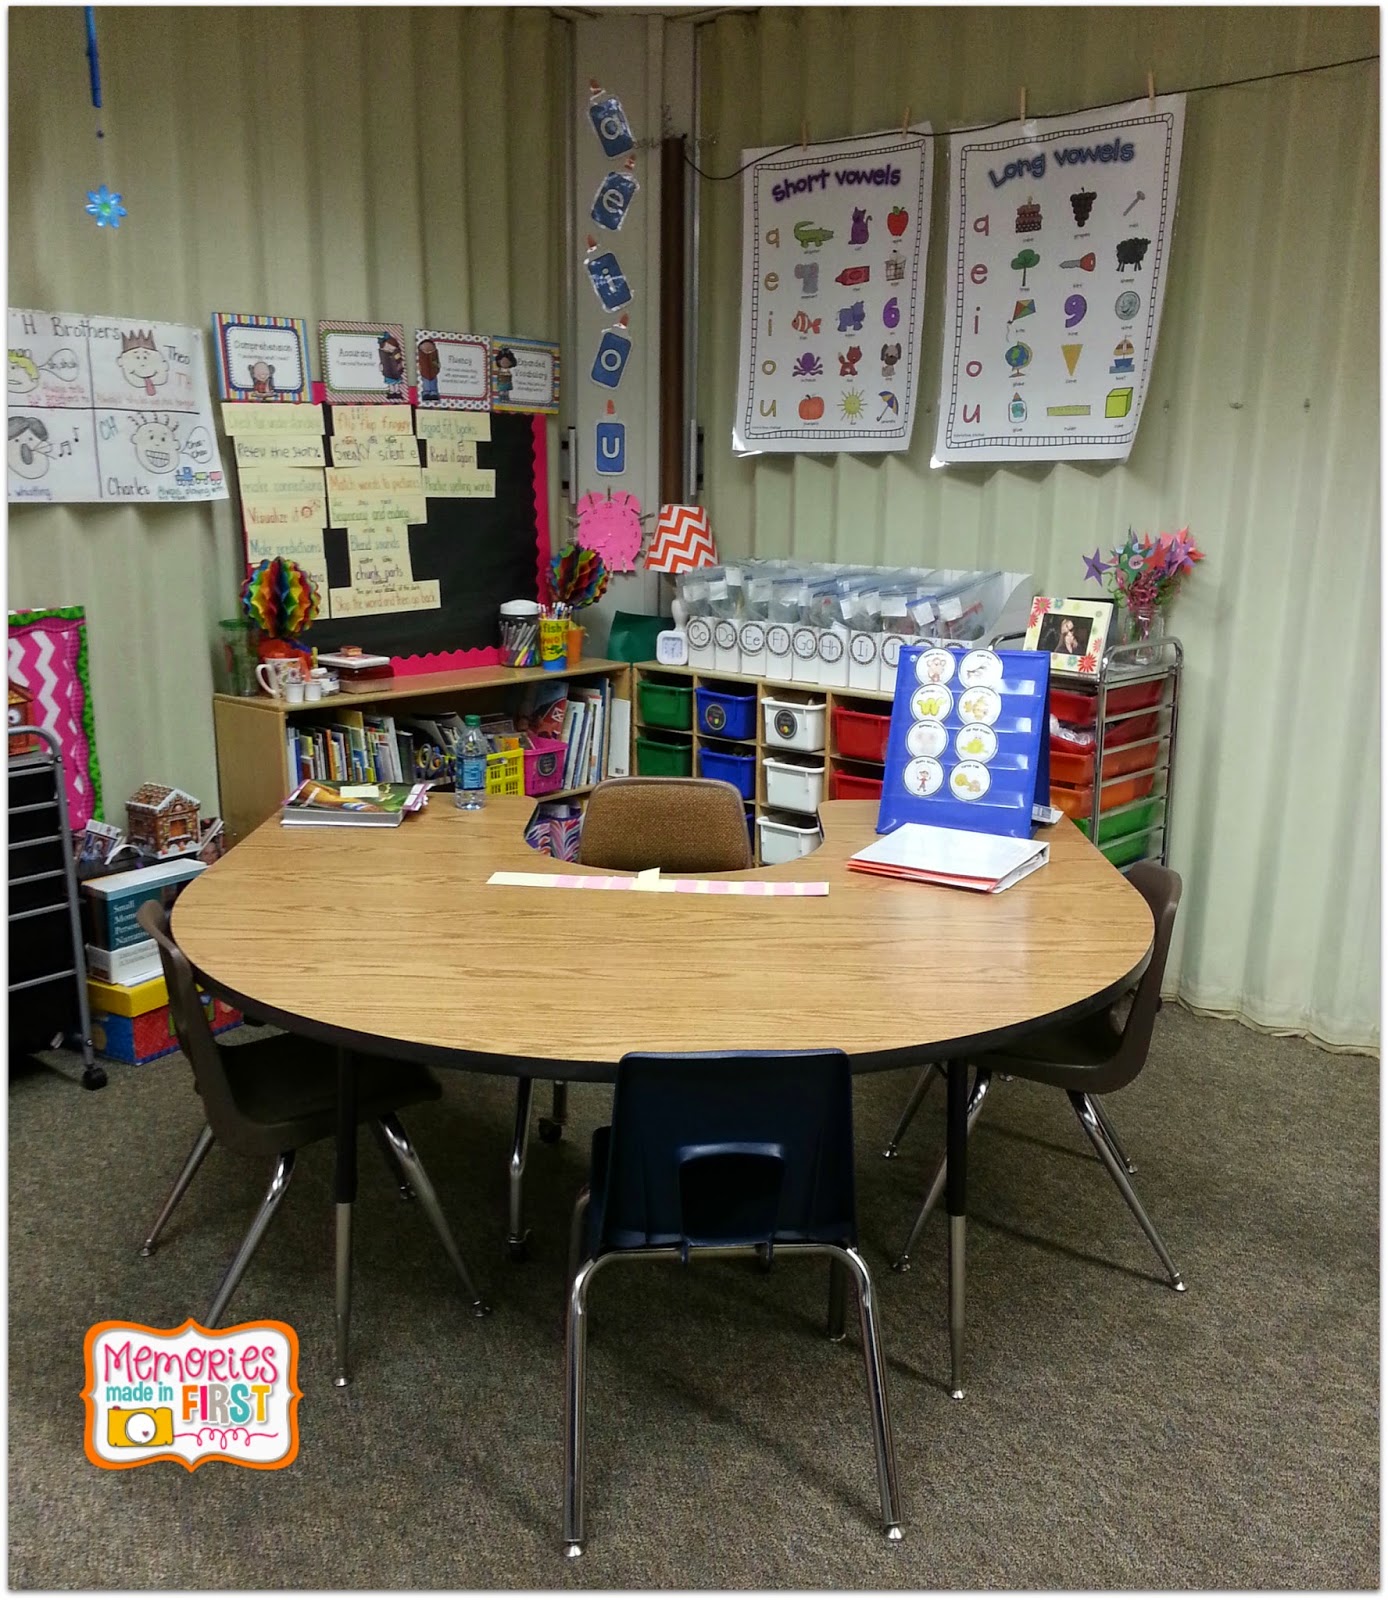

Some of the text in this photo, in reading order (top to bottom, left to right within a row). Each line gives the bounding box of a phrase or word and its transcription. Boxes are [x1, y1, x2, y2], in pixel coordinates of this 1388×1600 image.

[988, 137, 1135, 189] Long vowels
[772, 164, 901, 203] short vowels
[602, 188, 625, 213] e
[973, 214, 990, 236] a
[765, 228, 780, 248] a
[764, 272, 779, 291] e
[970, 263, 988, 285] e
[767, 310, 774, 337] i
[882, 296, 900, 329] 6
[974, 306, 981, 335] i
[22, 315, 121, 341] H Brothers
[762, 359, 777, 376] o
[966, 360, 983, 378] o
[107, 476, 150, 496] Charles
[745, 629, 761, 646] Ee
[113, 900, 135, 913] Small
[114, 912, 138, 924] Mome
